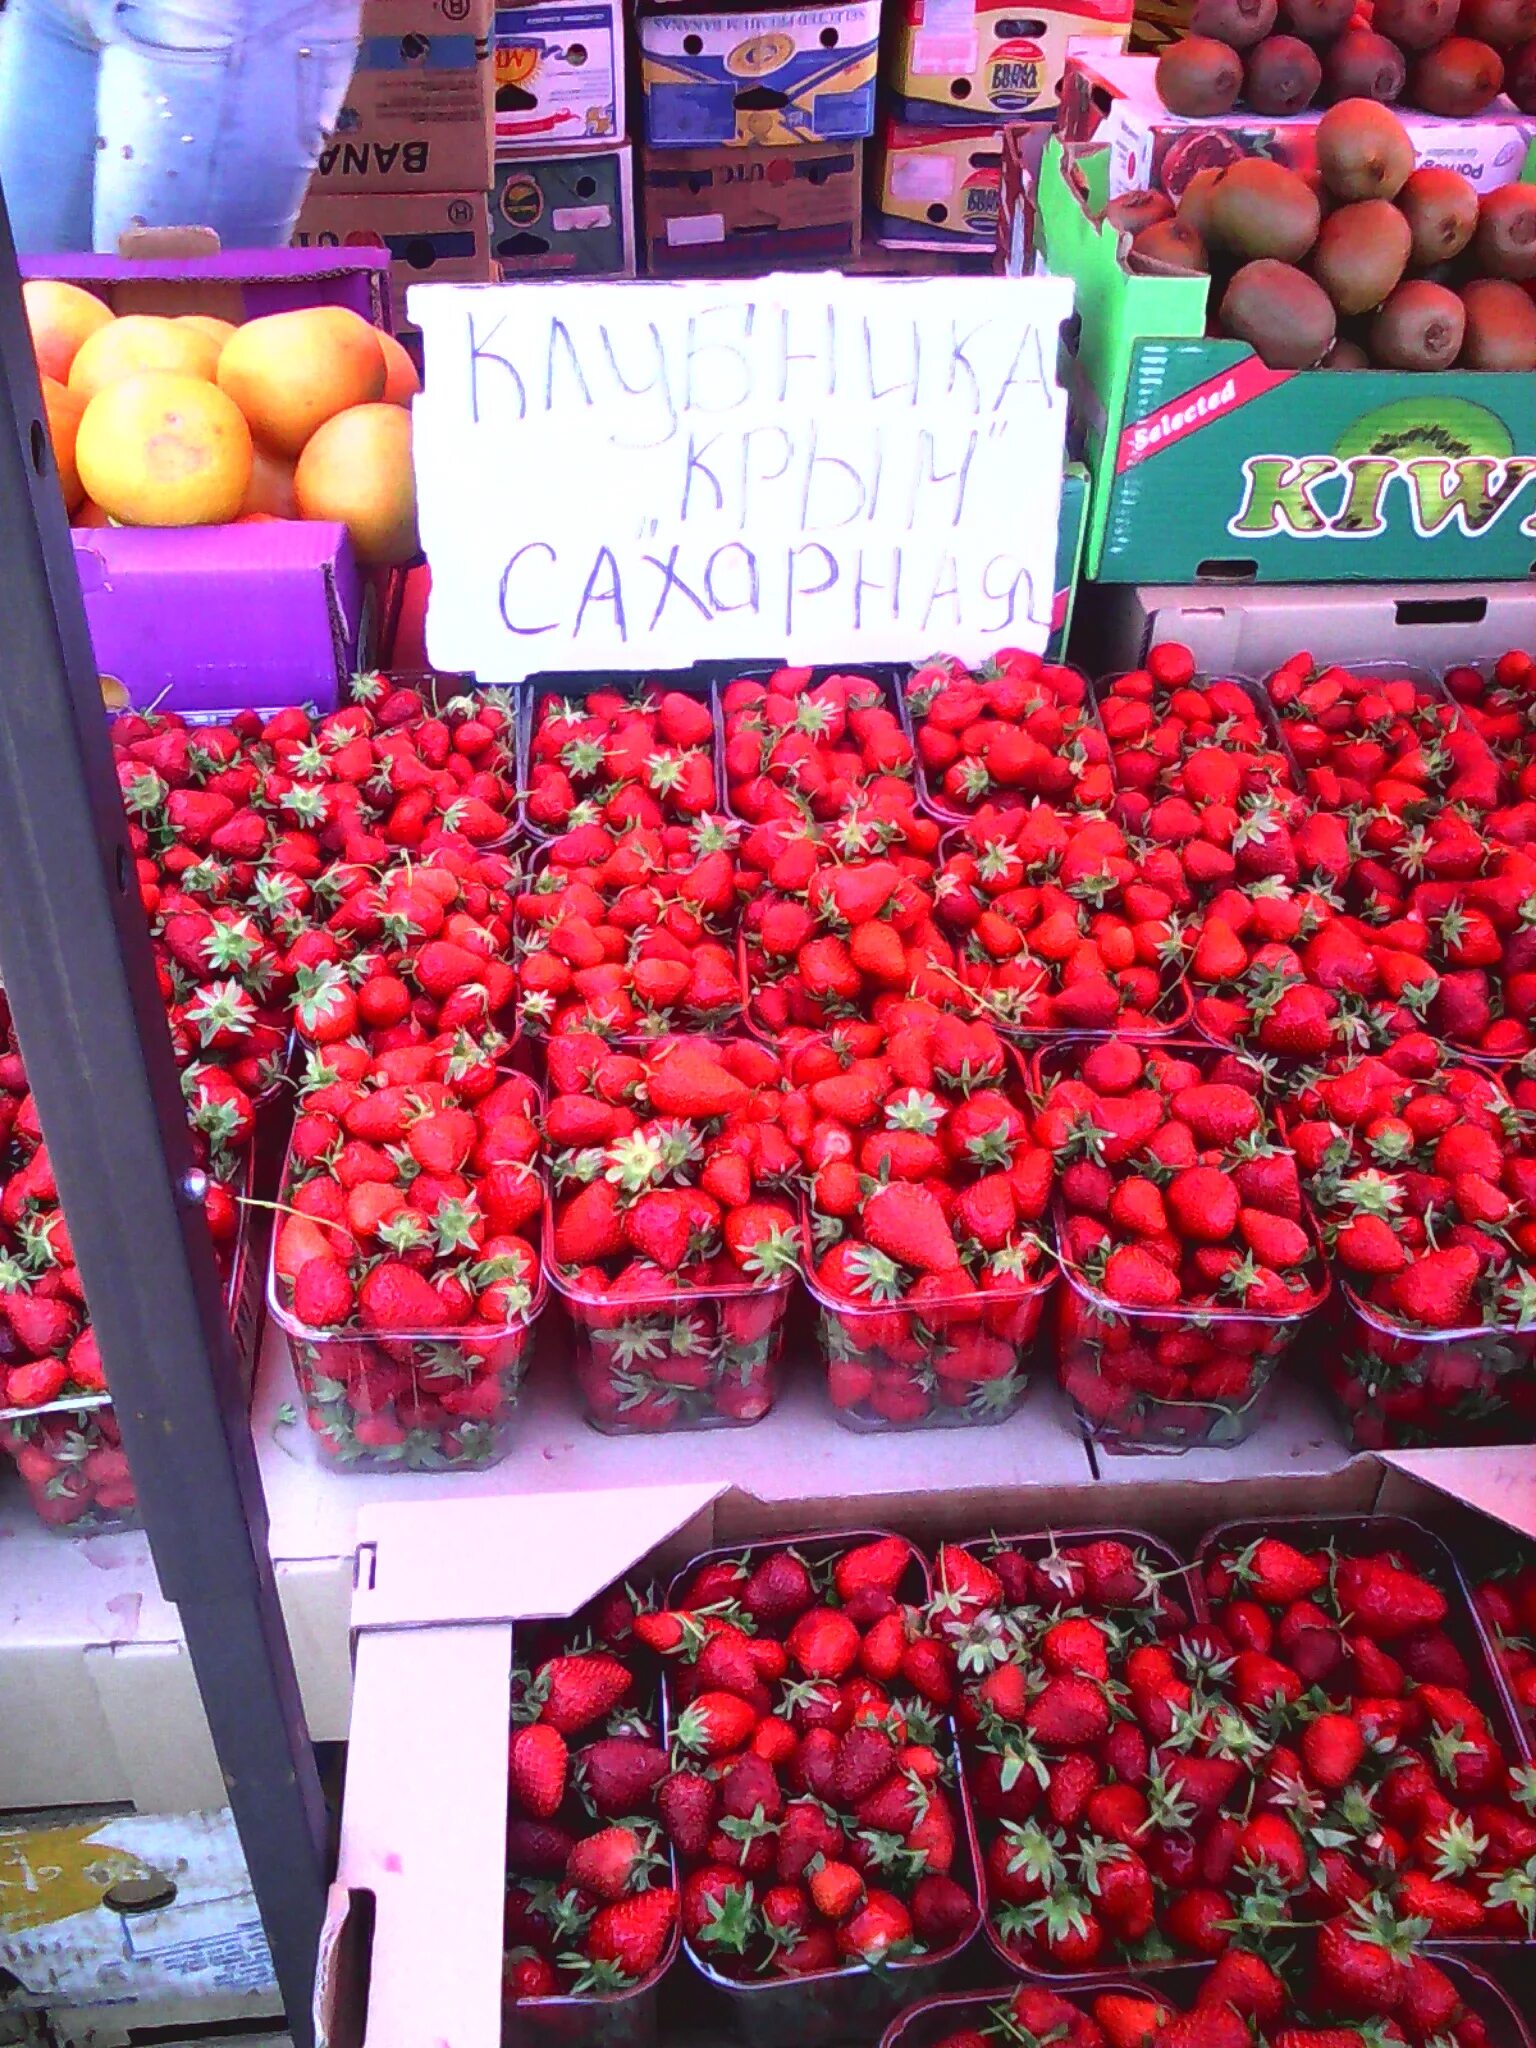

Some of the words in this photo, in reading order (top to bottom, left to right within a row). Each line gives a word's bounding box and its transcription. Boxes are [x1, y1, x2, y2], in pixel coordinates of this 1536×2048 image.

[653, 16, 722, 31] BANANAS
[467, 302, 1053, 449] КЛУБНИКА
[1133, 378, 1237, 452] Selected
